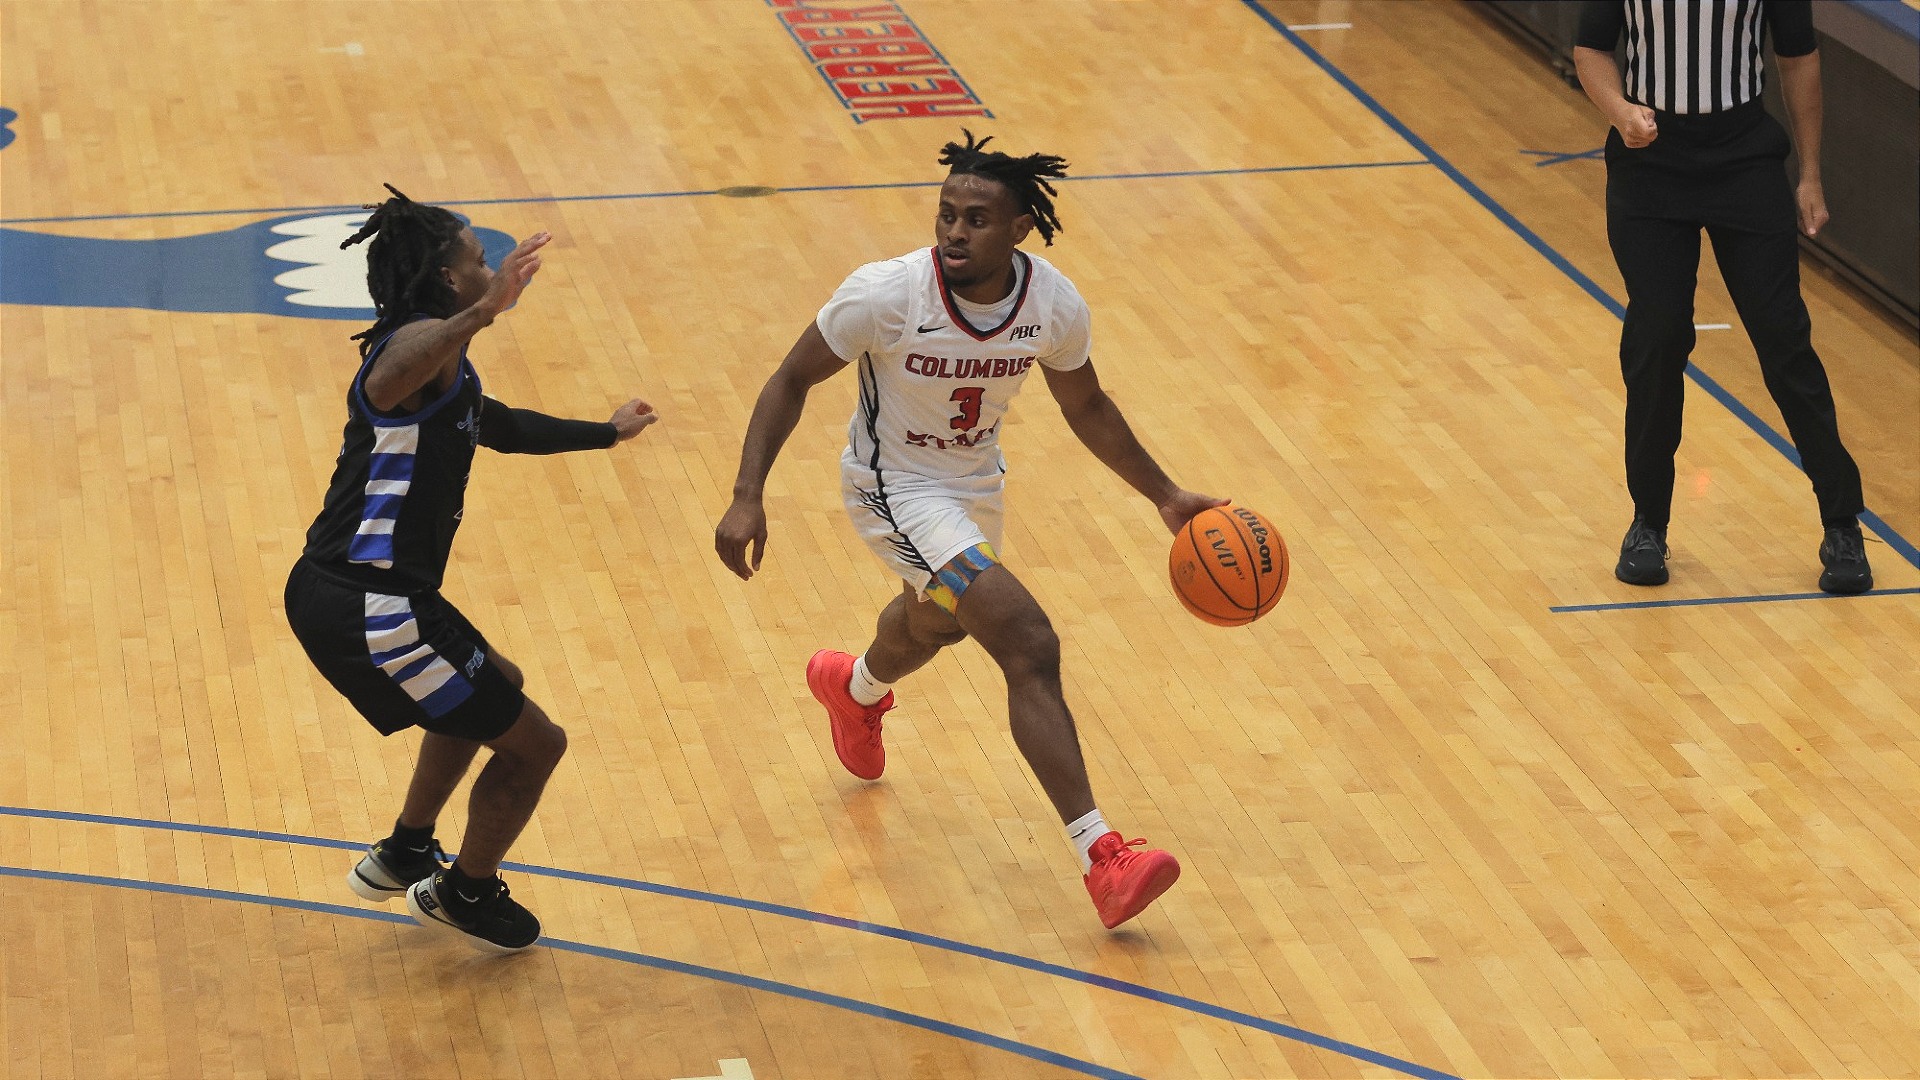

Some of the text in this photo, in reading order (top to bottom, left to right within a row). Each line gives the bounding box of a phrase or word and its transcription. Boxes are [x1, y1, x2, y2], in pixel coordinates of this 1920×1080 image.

[1009, 324, 1042, 342] PBC
[904, 352, 1037, 379] COLUMBUS
[949, 386, 986, 432] 3
[904, 416, 1000, 450] STA
[1232, 507, 1273, 575] Wilson
